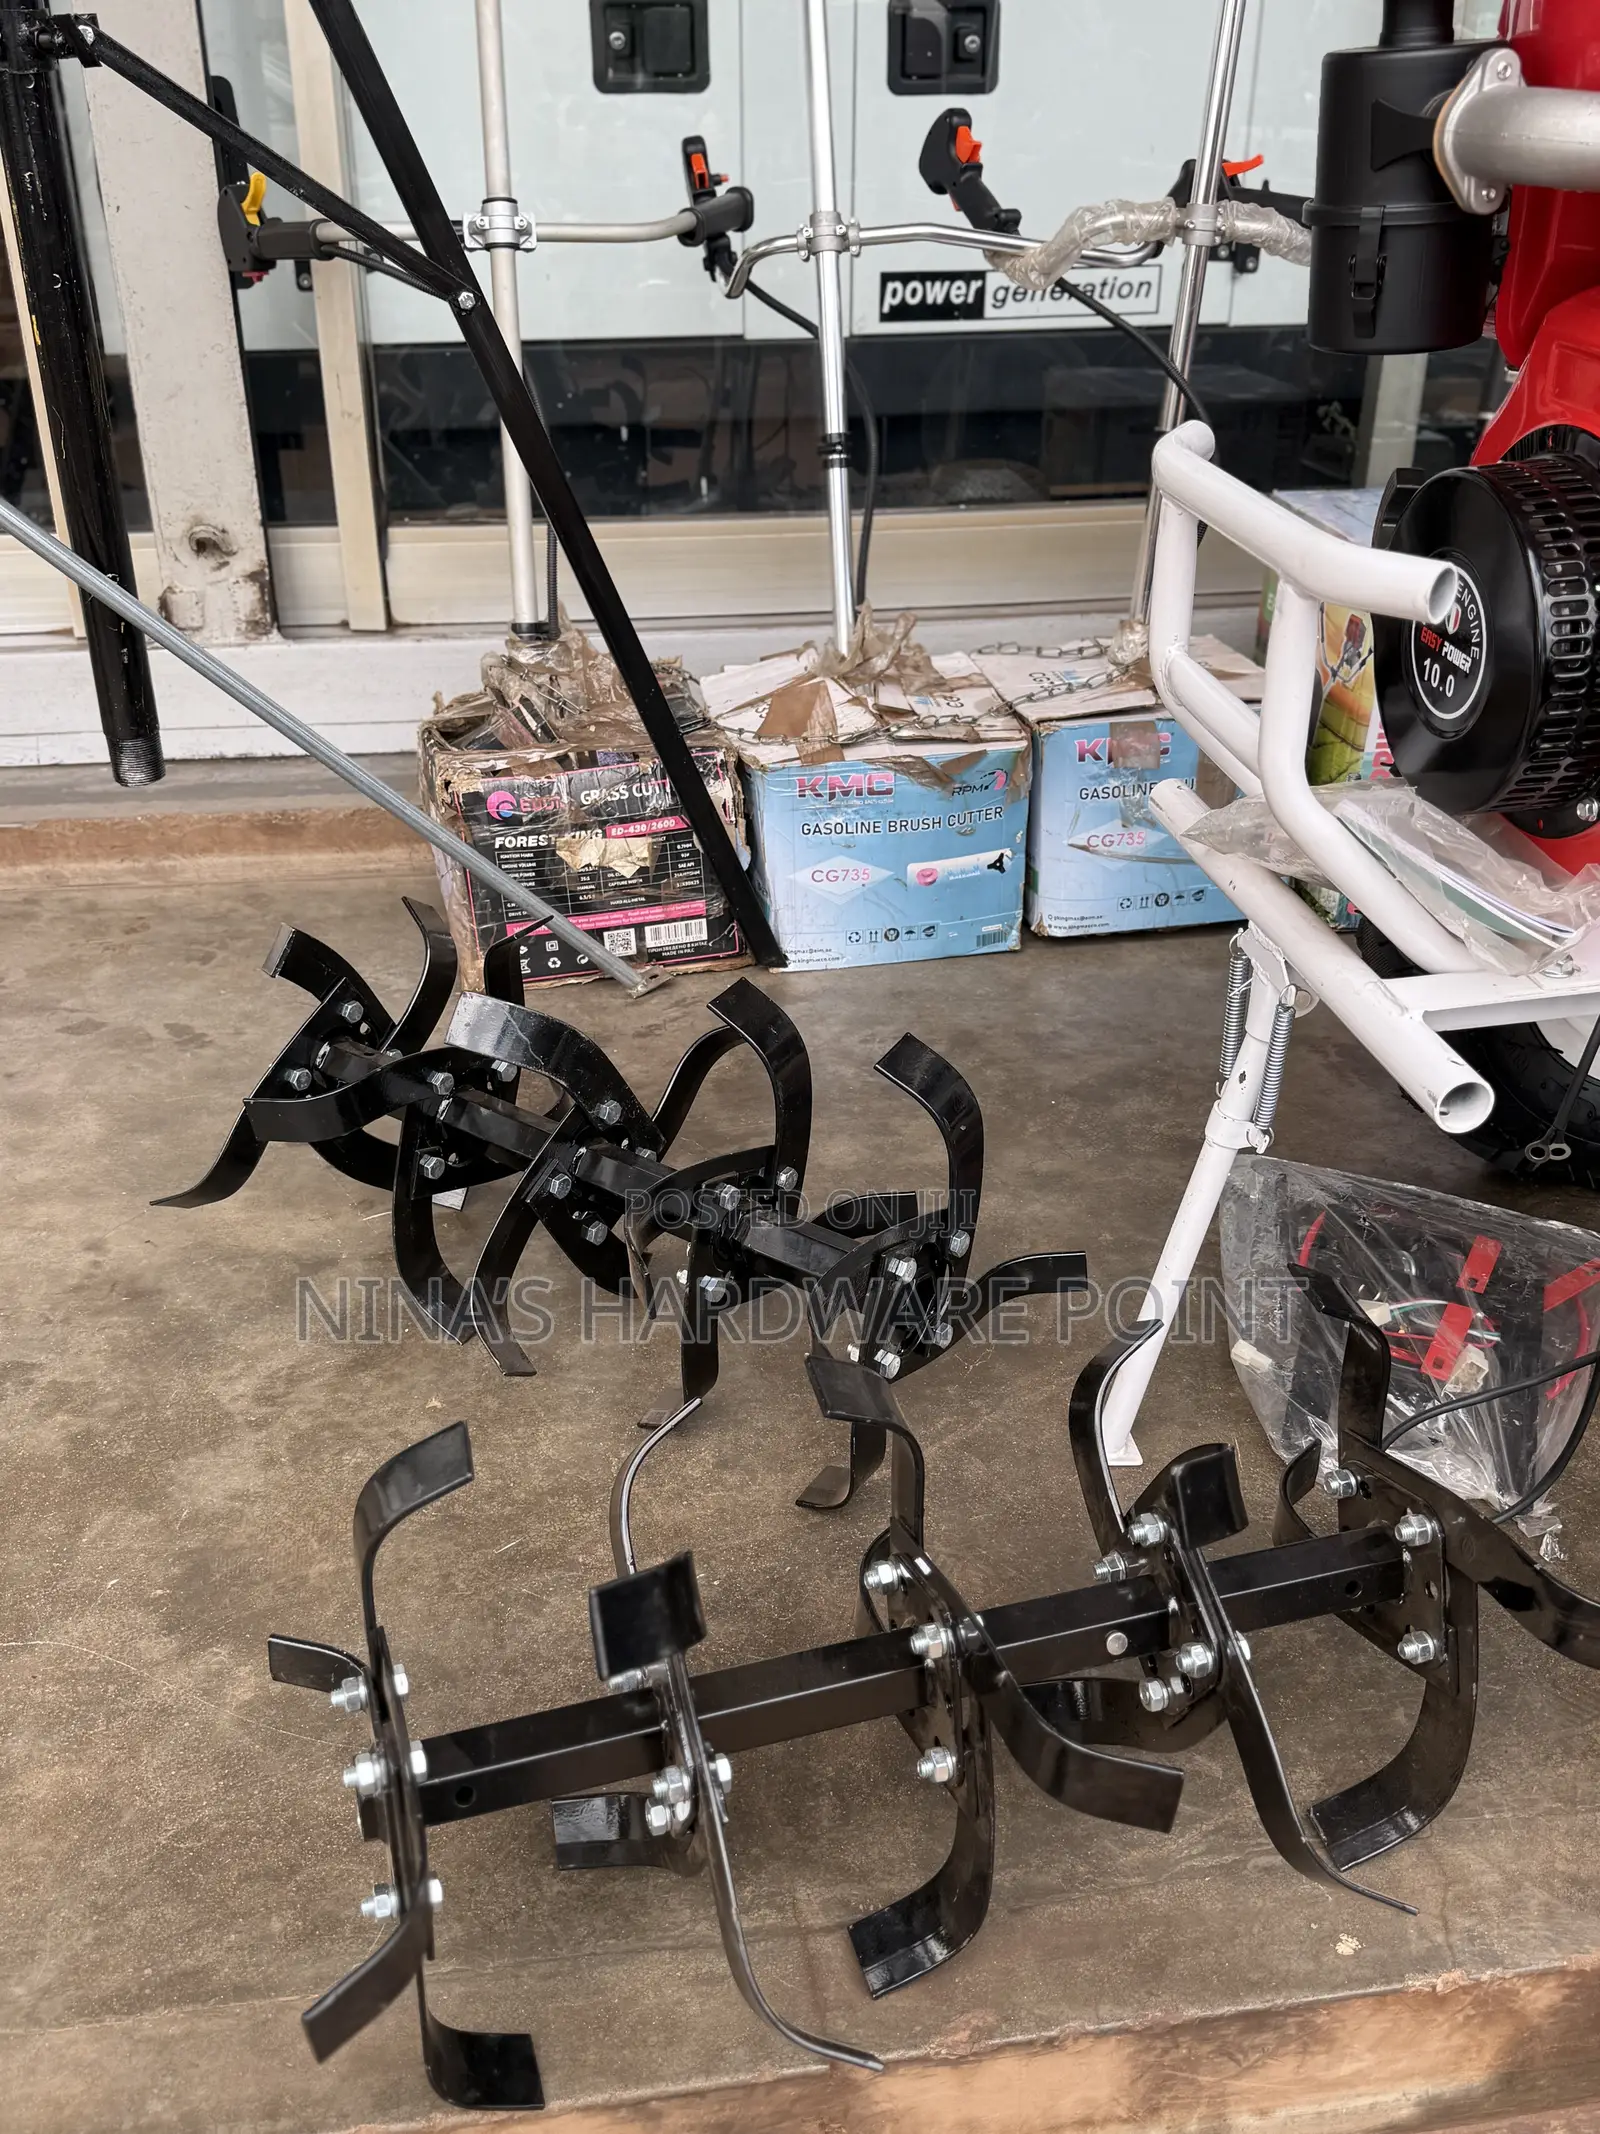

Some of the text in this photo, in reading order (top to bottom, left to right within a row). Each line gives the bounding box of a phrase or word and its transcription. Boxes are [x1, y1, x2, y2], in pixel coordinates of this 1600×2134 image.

[881, 278, 984, 313] power
[1456, 580, 1480, 660] ENGINE
[1420, 626, 1472, 674] EASY POWER
[1423, 658, 1455, 697] 10.0
[580, 778, 671, 805] GRASS CUTT
[796, 772, 895, 803] KMC
[952, 784, 984, 797] RPM
[1080, 782, 1157, 800] GASOLINE
[611, 819, 676, 836] ED-430/2600
[801, 806, 1004, 836] GASOLINE BRUSH CUTTER
[494, 834, 556, 849] FOREST
[1087, 832, 1146, 848] CG735
[811, 868, 871, 883] CG735
